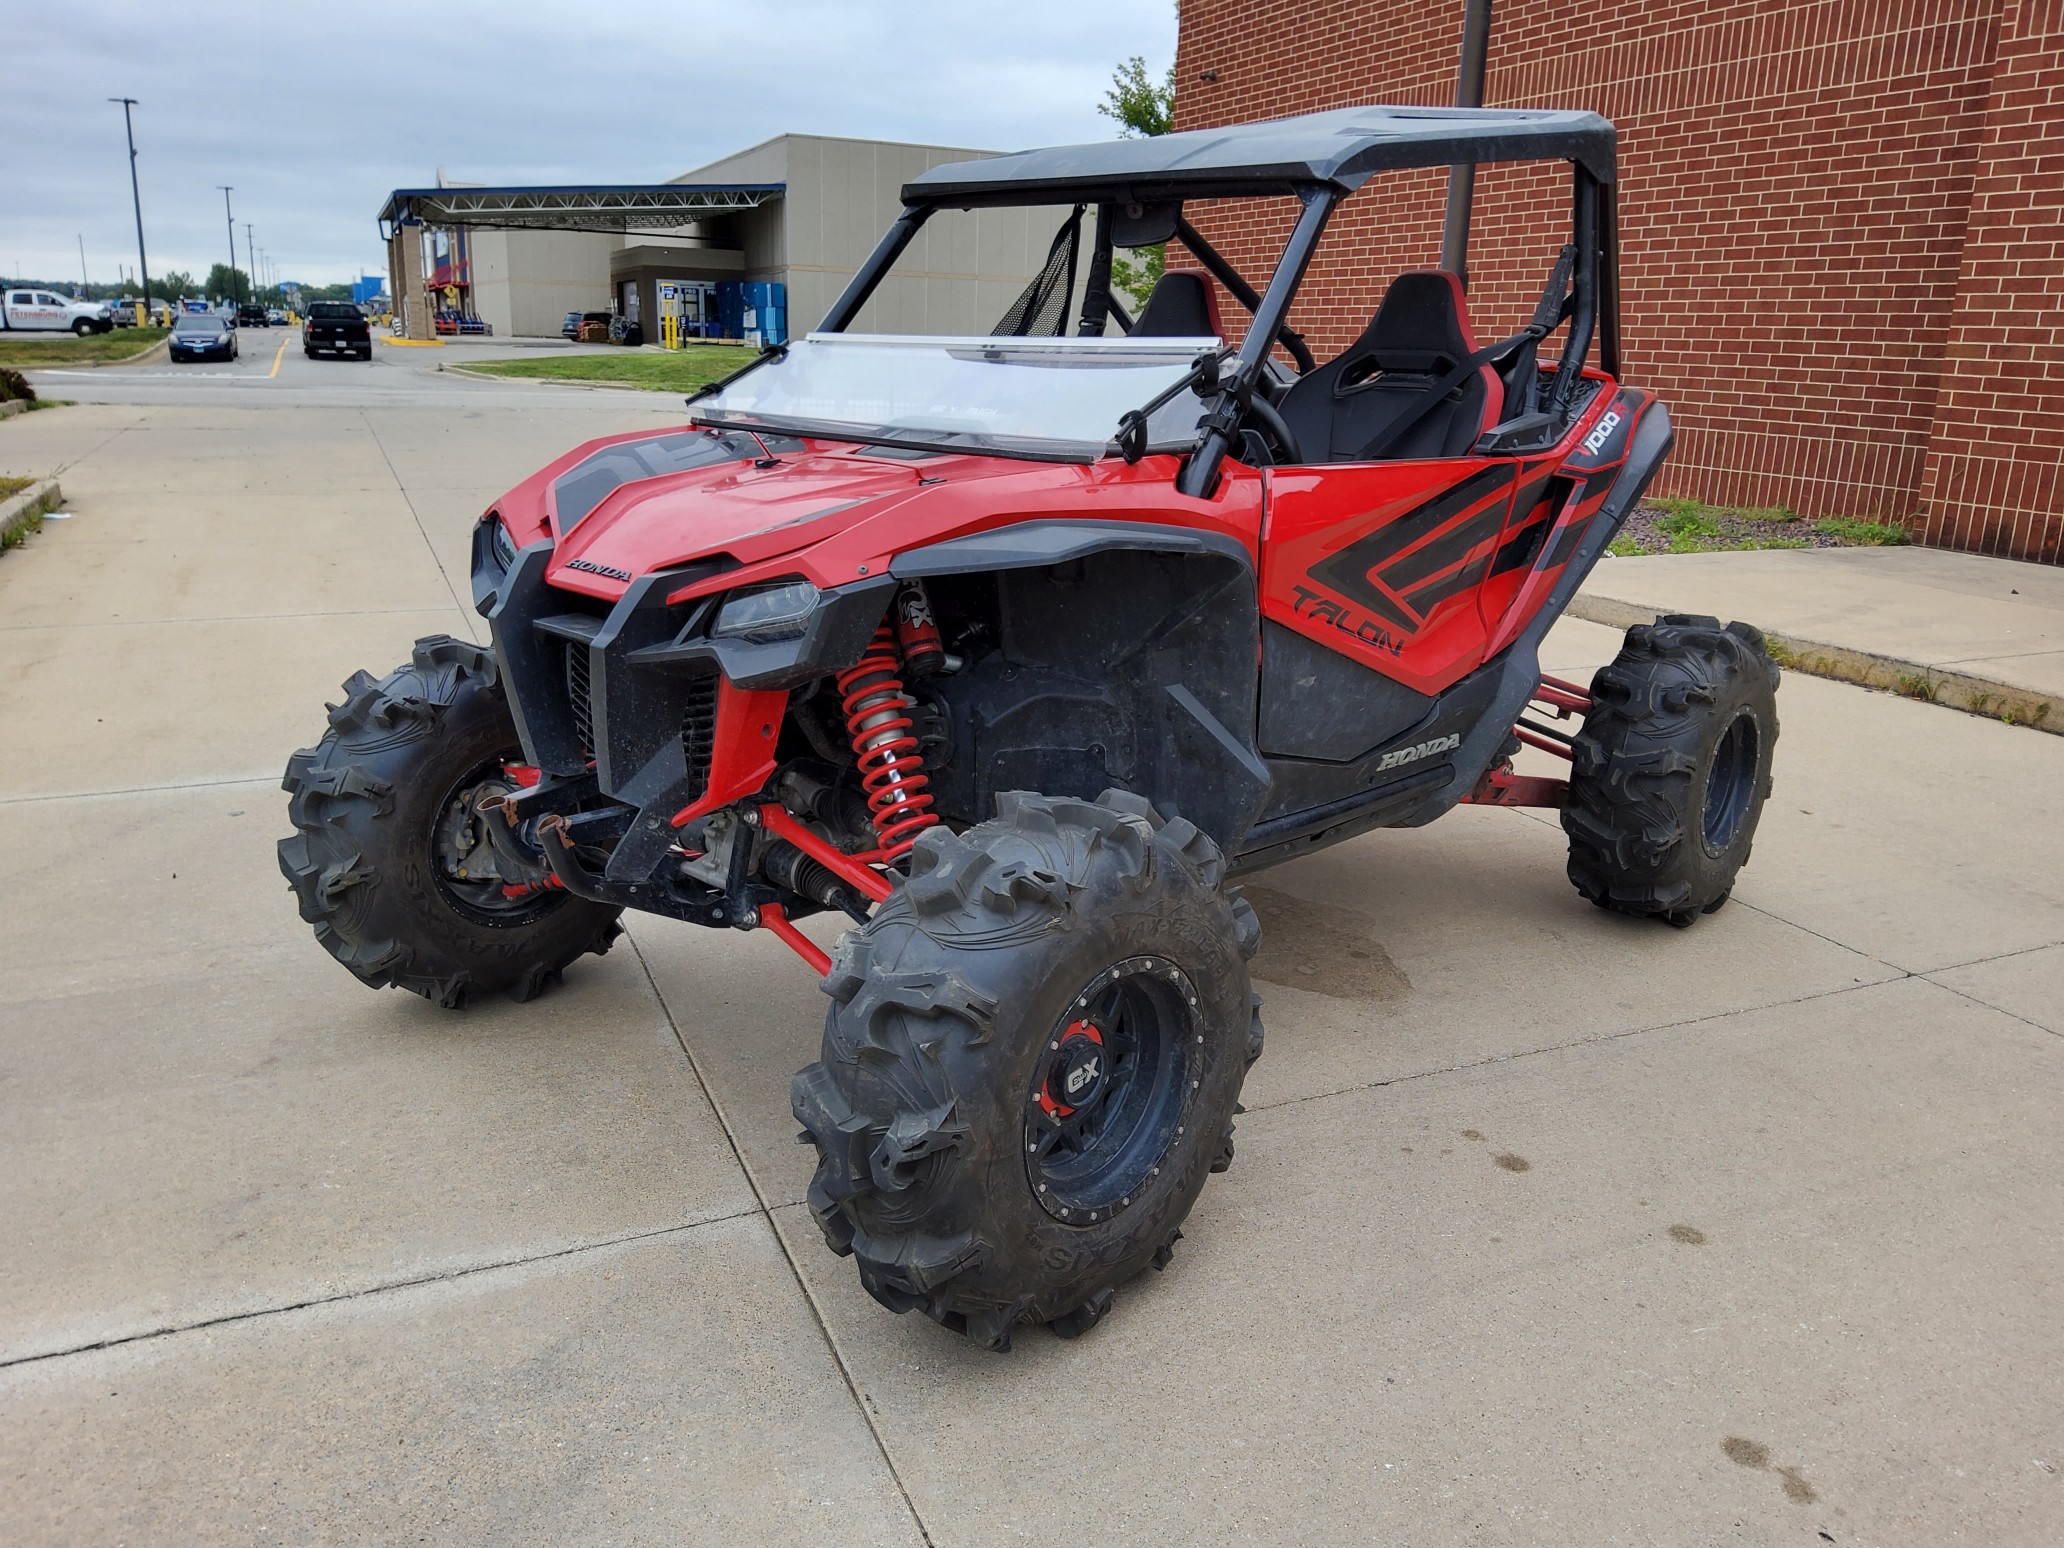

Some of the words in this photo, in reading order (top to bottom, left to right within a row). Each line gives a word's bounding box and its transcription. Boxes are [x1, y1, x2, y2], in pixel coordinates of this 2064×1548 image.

[1583, 402, 1630, 456] 1000R
[565, 559, 633, 583] HONDA
[1292, 585, 1405, 657] TALON
[1376, 732, 1460, 772] HONDA
